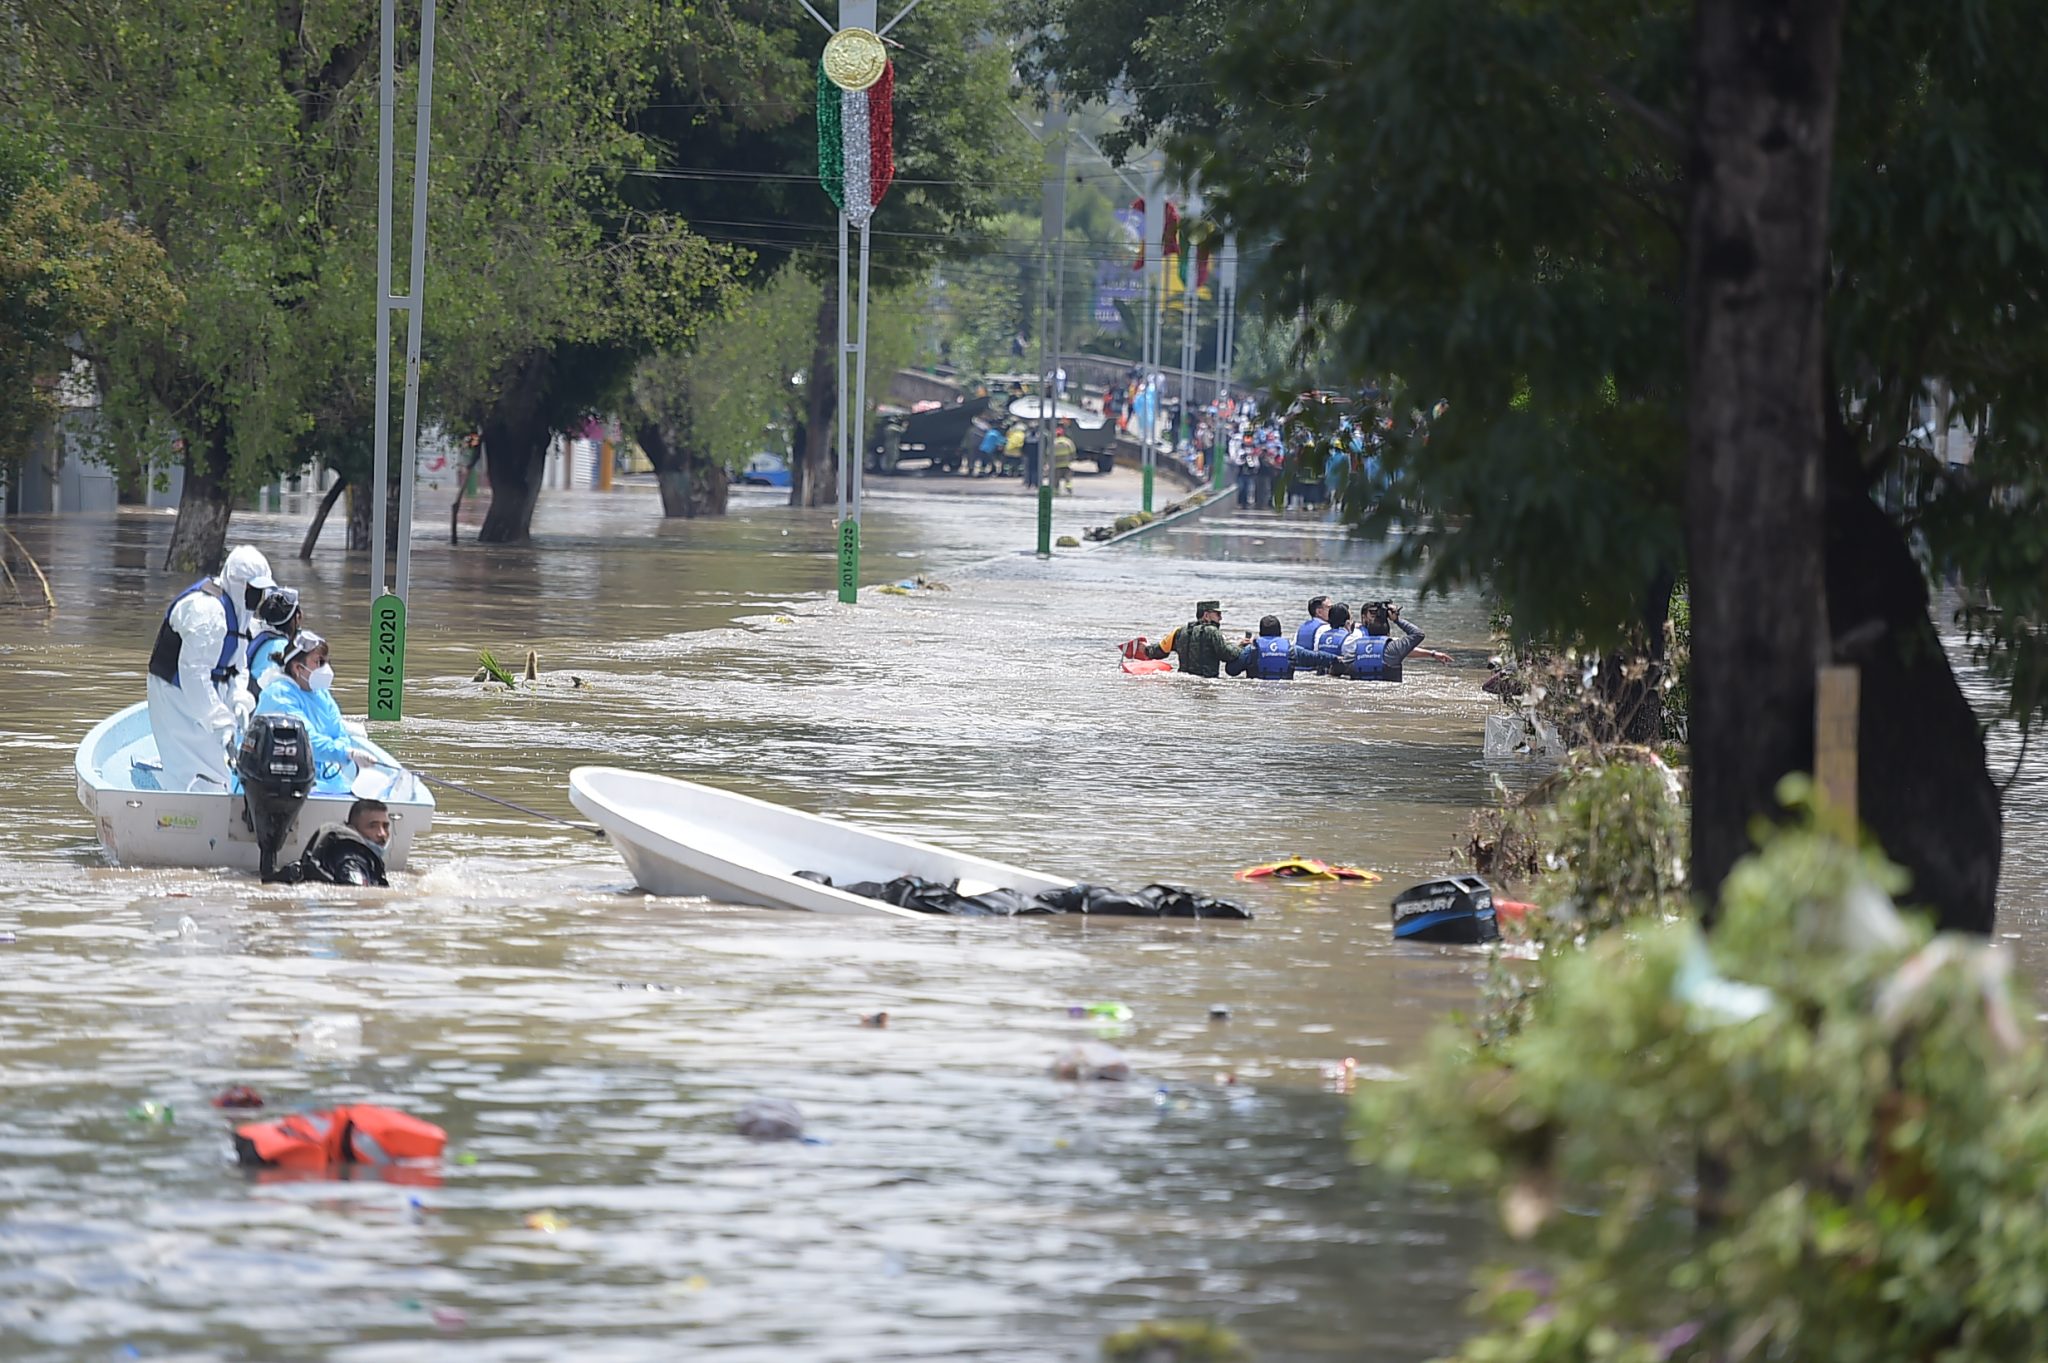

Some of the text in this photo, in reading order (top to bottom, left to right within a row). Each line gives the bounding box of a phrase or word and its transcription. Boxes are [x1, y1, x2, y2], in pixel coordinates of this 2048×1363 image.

[843, 527, 853, 587] 2016-2020
[377, 609, 396, 710] 2016-2020
[273, 746, 297, 756] 20
[1395, 897, 1456, 920] MERCURY
